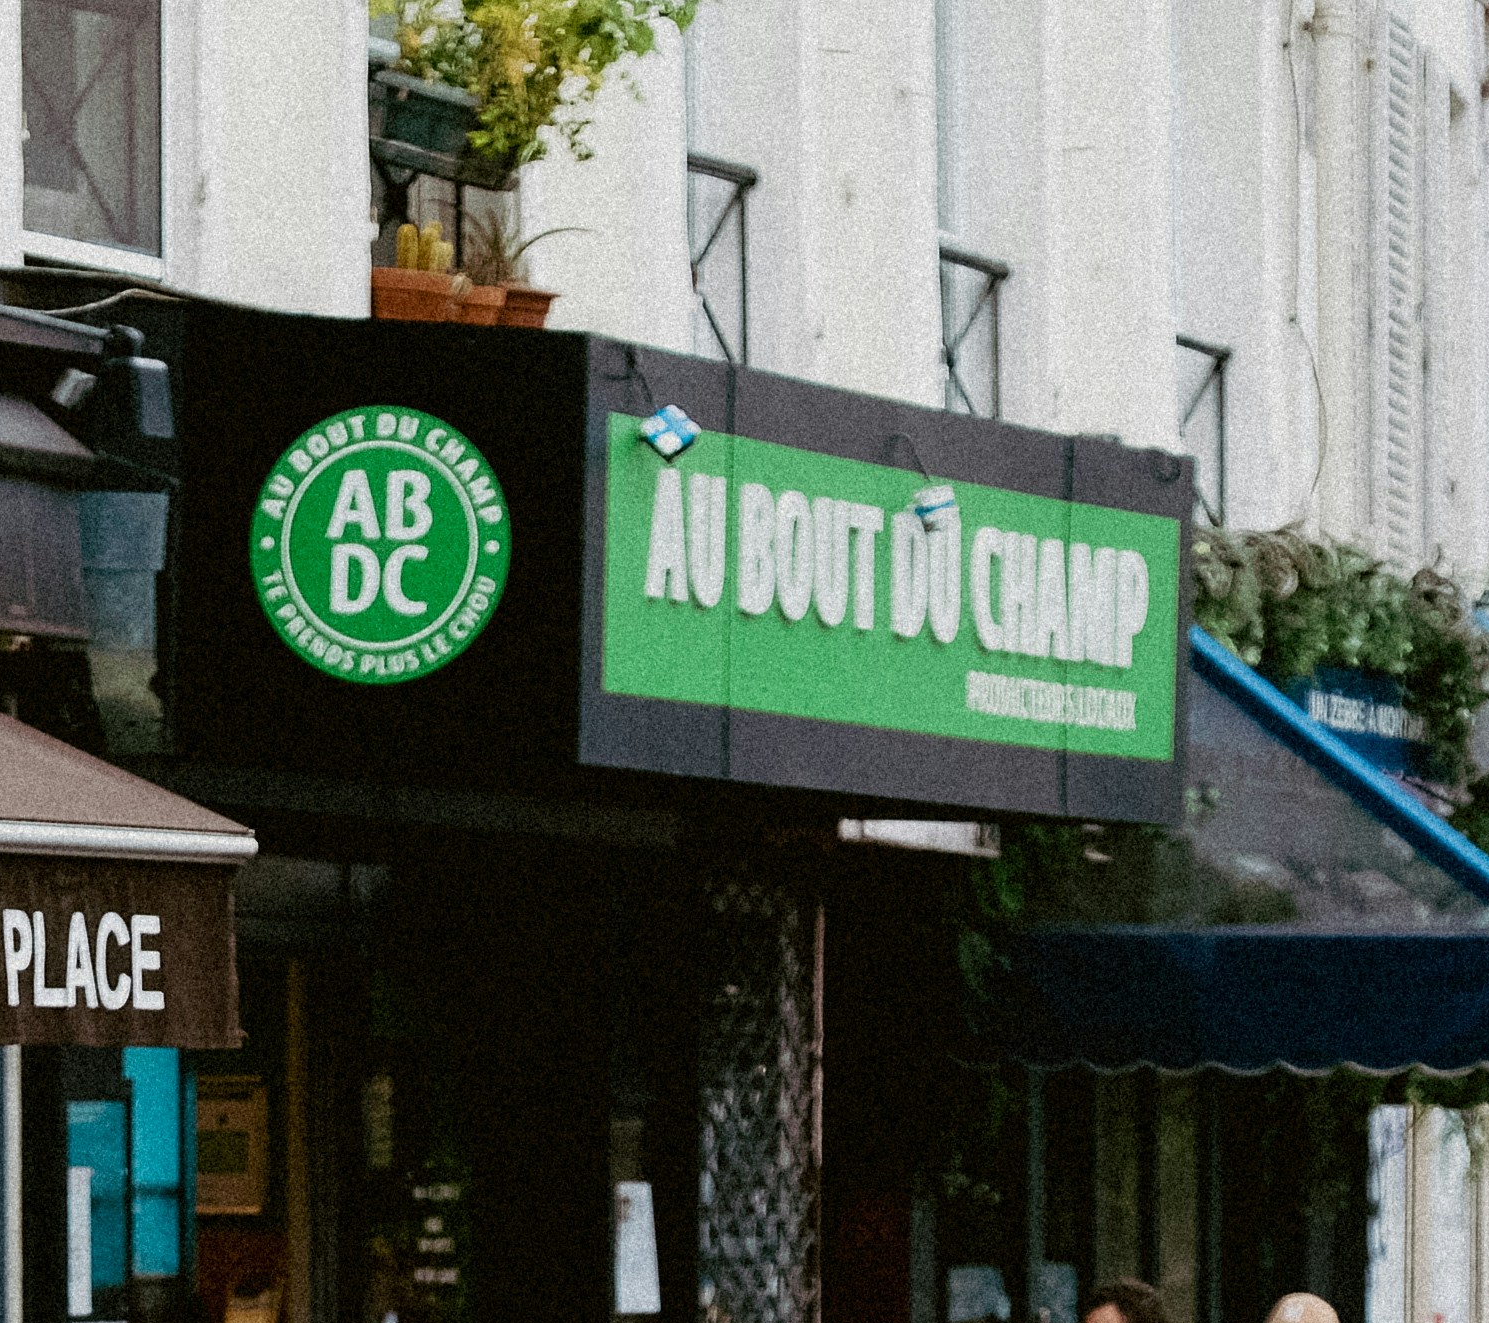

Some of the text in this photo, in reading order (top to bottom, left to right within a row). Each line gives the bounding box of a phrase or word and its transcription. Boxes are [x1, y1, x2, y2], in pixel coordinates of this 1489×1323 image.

[262, 413, 503, 524] AU BOUT DU CHAMP
[325, 469, 433, 541] AB
[329, 543, 429, 616] DC
[645, 468, 1149, 667] AU BOUT DU CHAMP
[360, 650, 420, 676] PLUS
[421, 634, 452, 664] LE
[448, 575, 497, 641] CHOU
[3, 908, 165, 1011] PLACE
